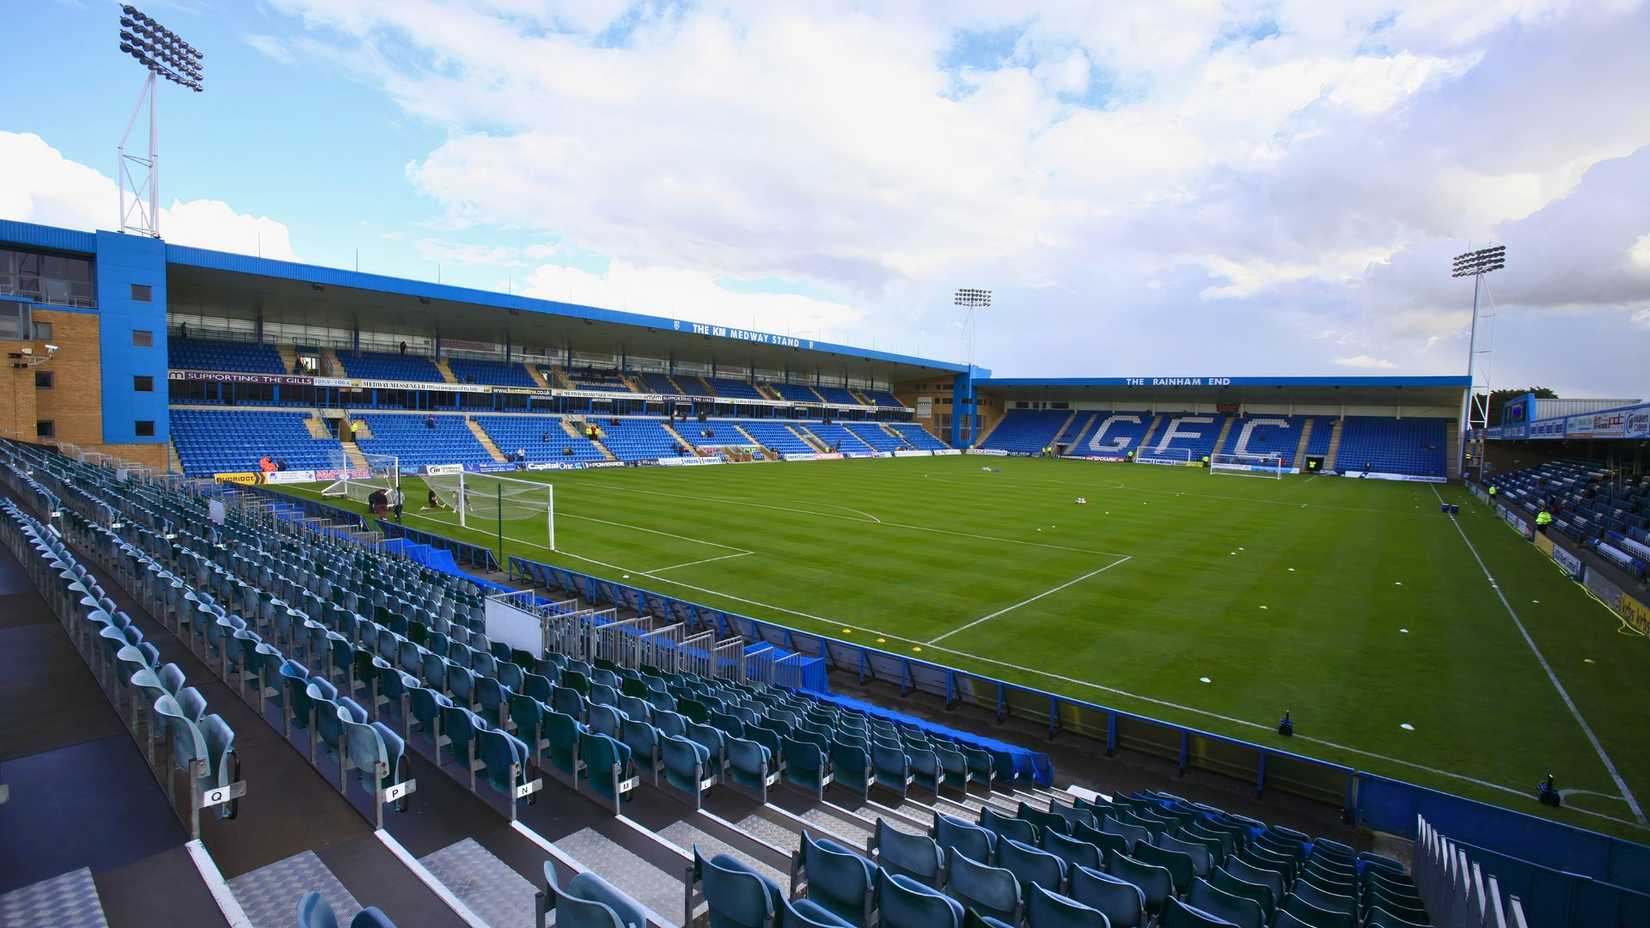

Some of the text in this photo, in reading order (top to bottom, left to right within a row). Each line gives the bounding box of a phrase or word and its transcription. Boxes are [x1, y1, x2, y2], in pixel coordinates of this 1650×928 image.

[693, 324, 800, 347] THE KM MEDWAY STAND
[188, 372, 258, 383] SUPPORTING
[1126, 378, 1231, 386] THE RAINHAM END
[391, 789, 400, 798] P
[521, 787, 529, 795] N
[211, 791, 222, 802] Q
